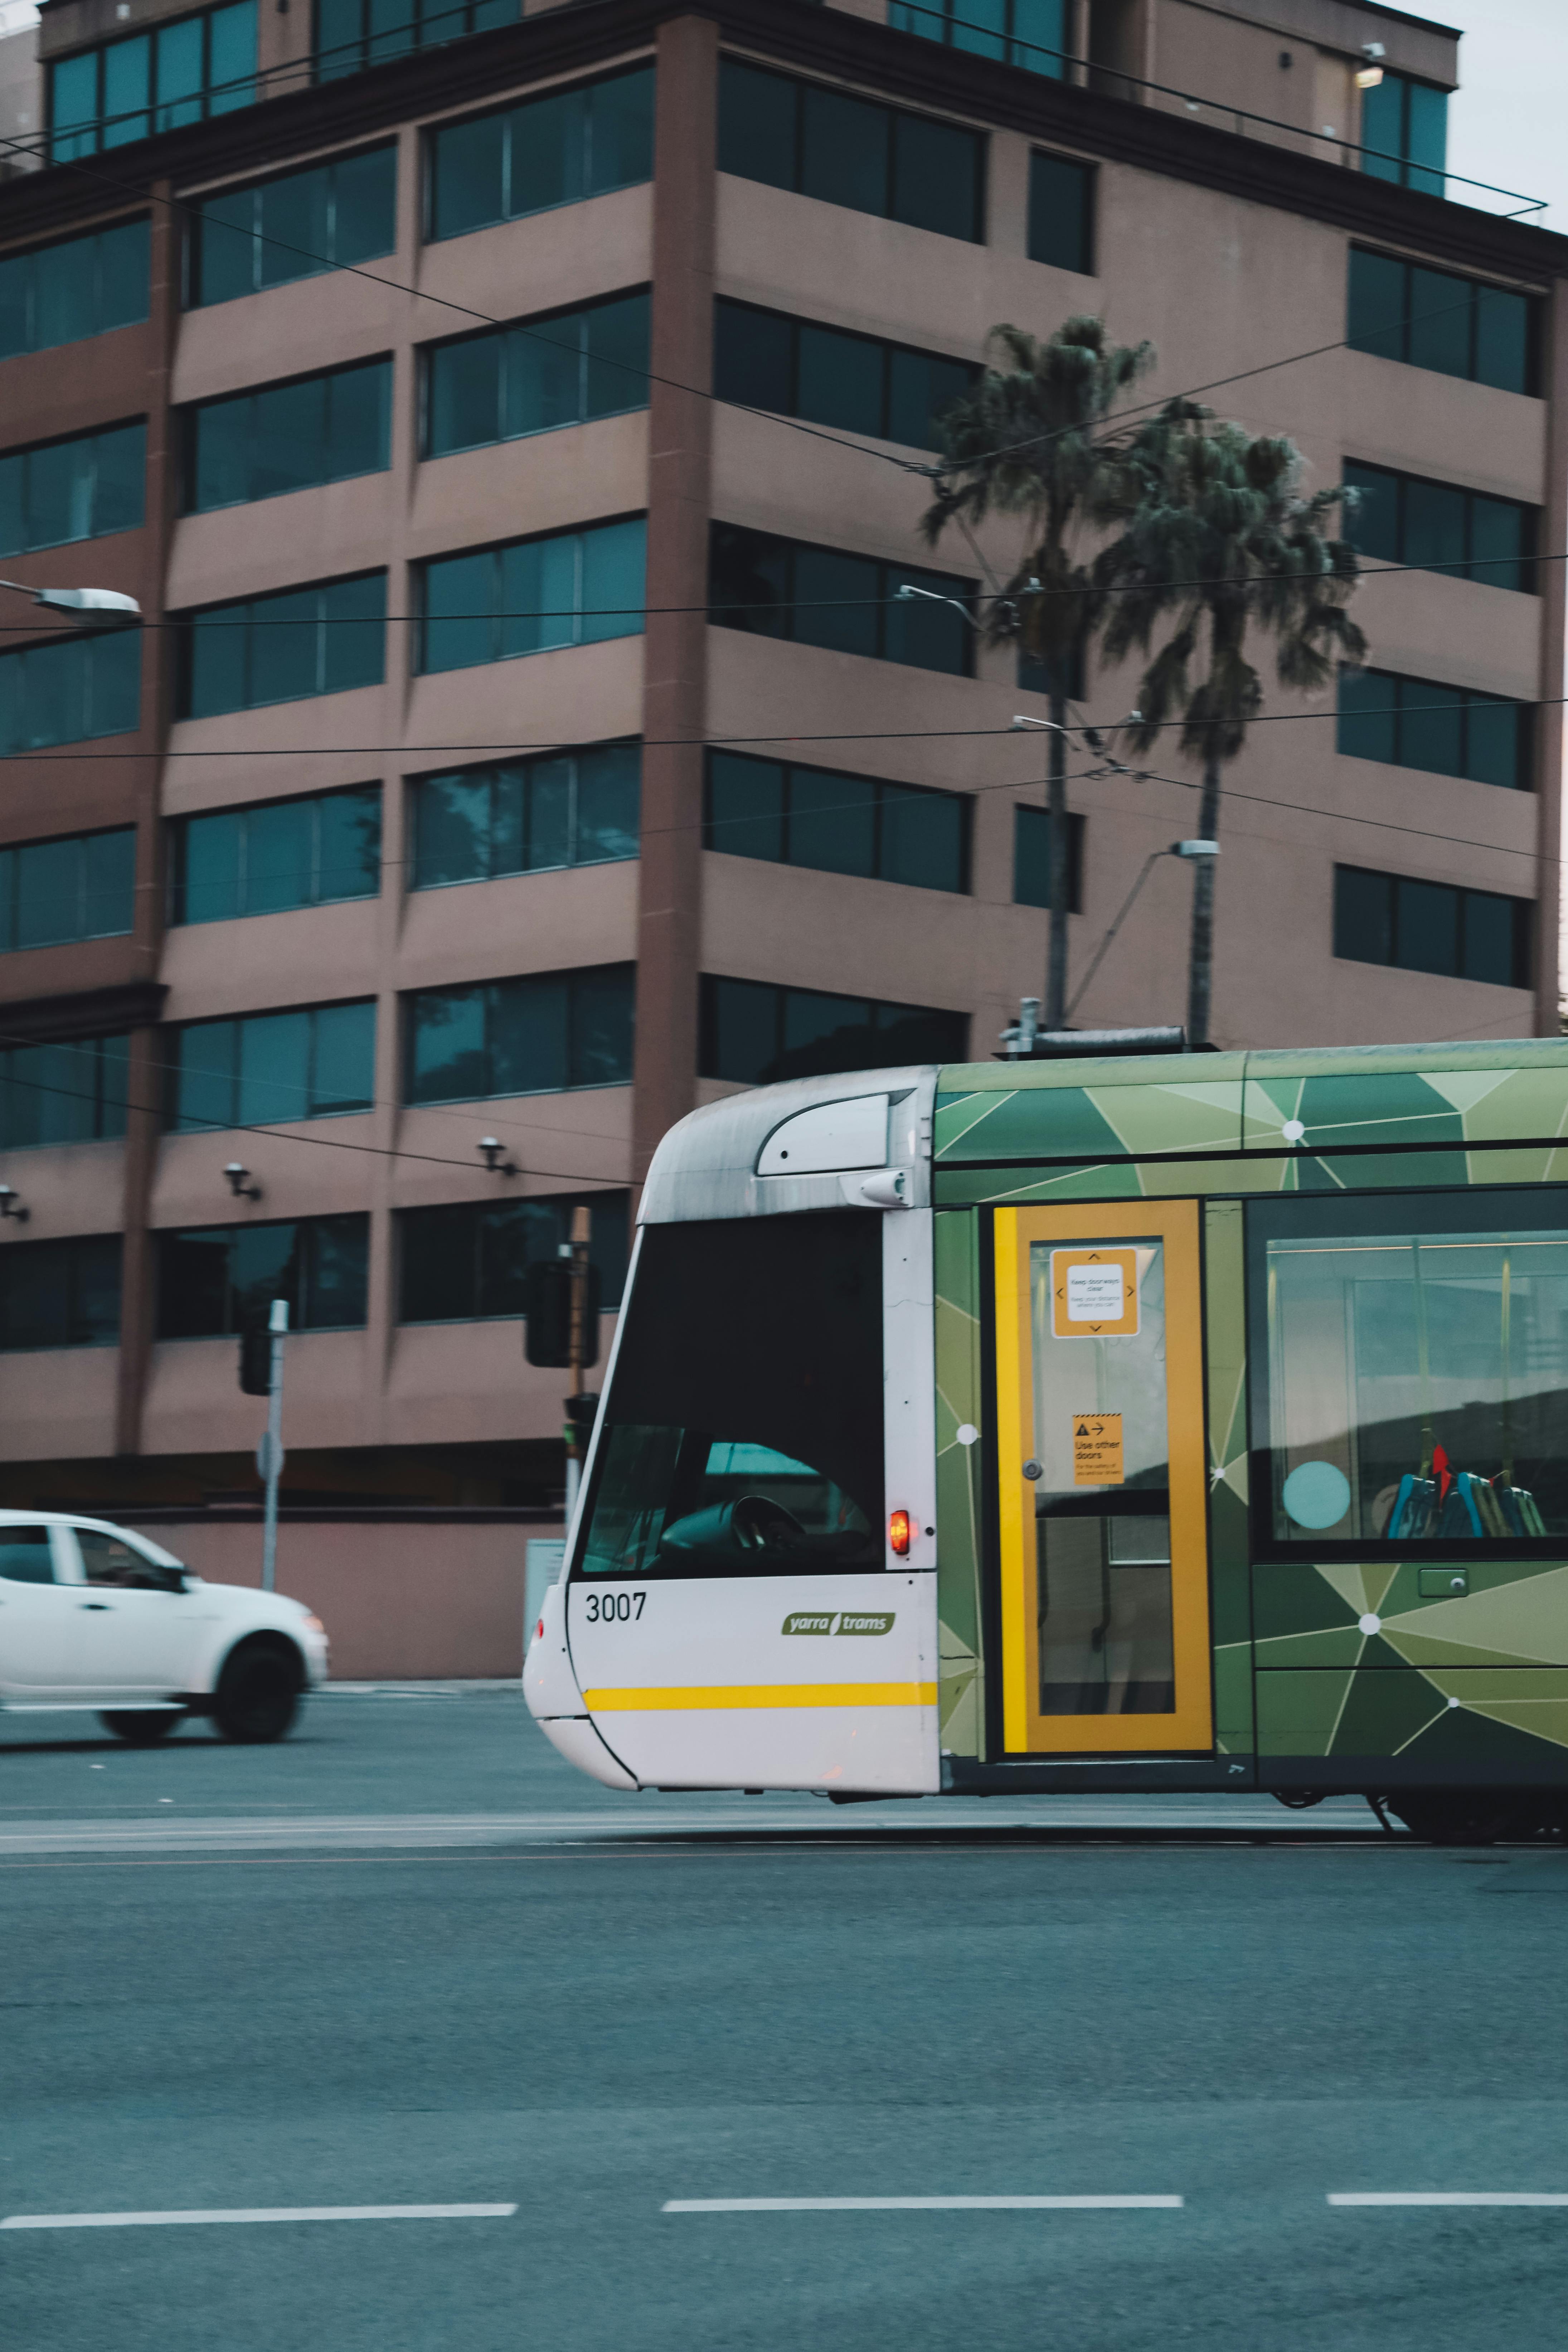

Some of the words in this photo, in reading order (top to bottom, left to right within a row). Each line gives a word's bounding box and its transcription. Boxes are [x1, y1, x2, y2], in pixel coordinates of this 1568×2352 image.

[1075, 1441, 1092, 1449] Use
[586, 1592, 646, 1622] 3007
[790, 1618, 829, 1633] yarra
[843, 1616, 887, 1630] trams
